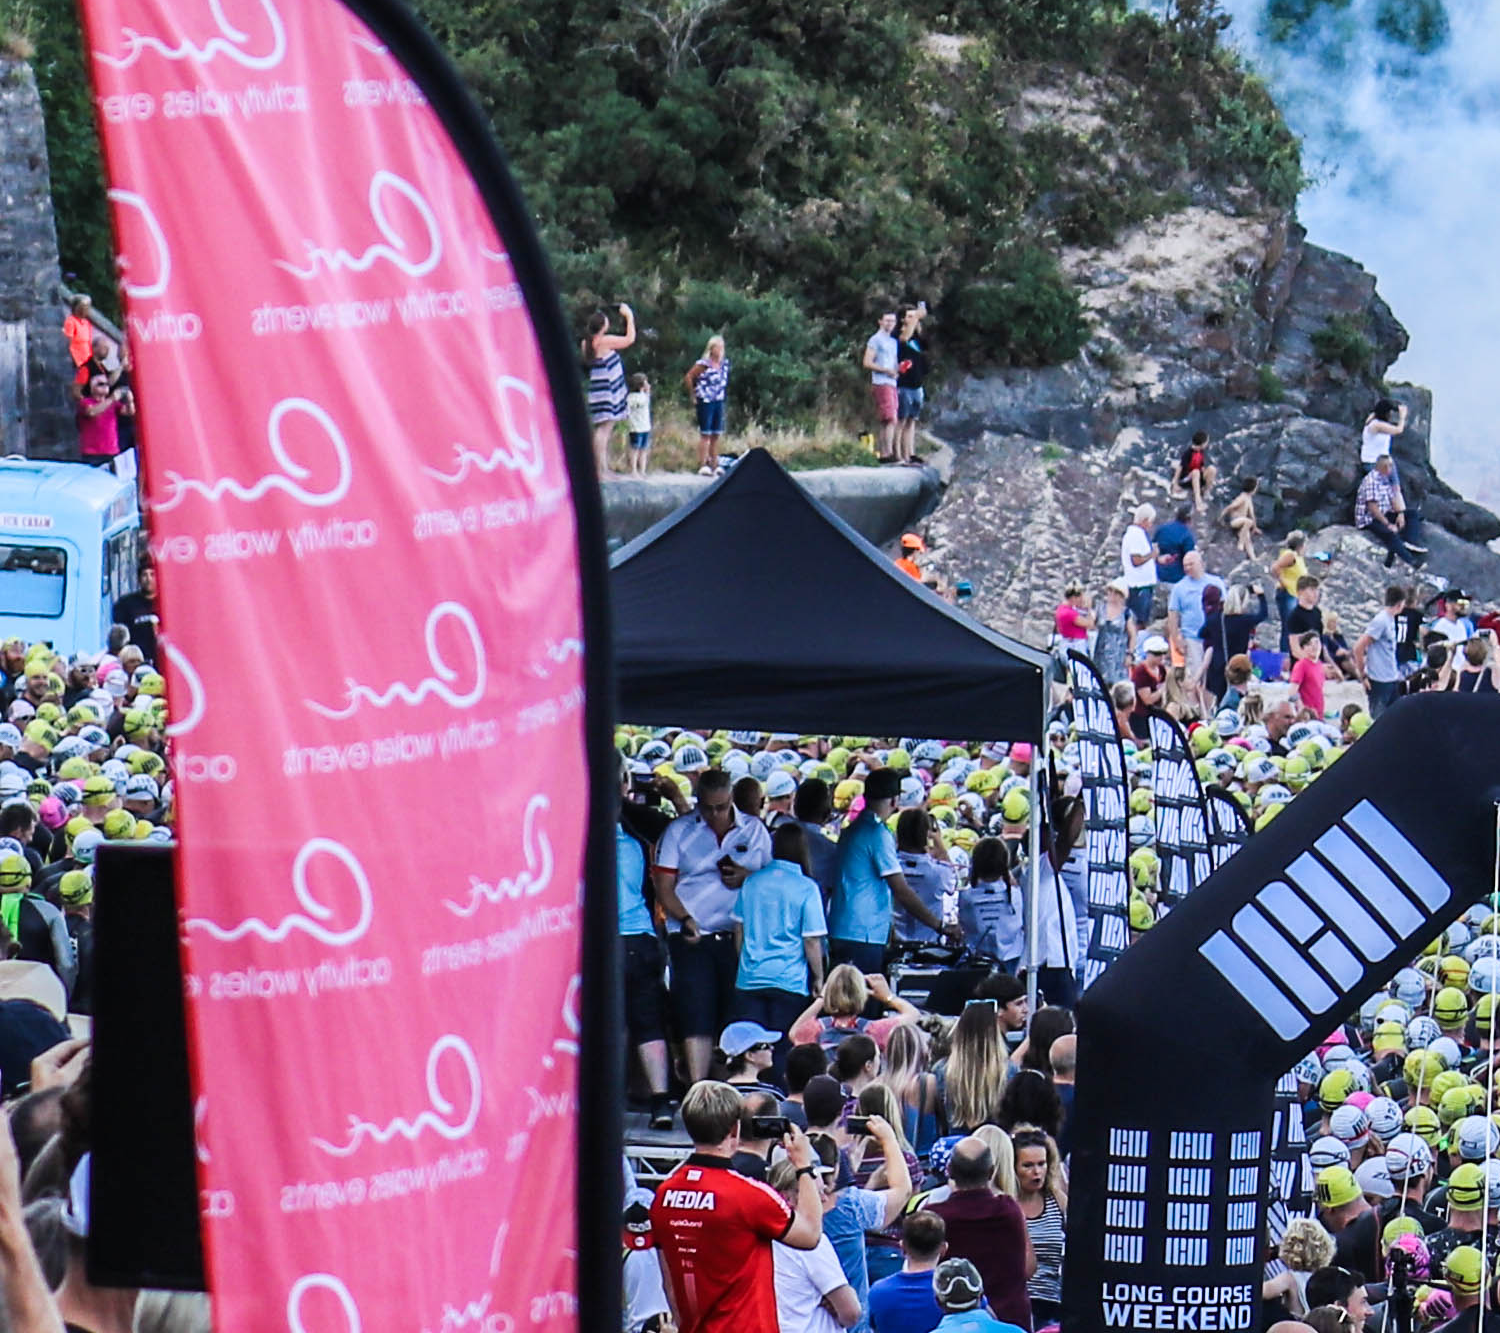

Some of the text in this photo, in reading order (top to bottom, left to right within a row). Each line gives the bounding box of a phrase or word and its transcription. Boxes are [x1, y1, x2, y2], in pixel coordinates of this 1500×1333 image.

[662, 1189, 715, 1210] MEDIA
[1102, 1282, 1253, 1305] LONG COURSE
[1102, 1301, 1253, 1331] WEEKEND
